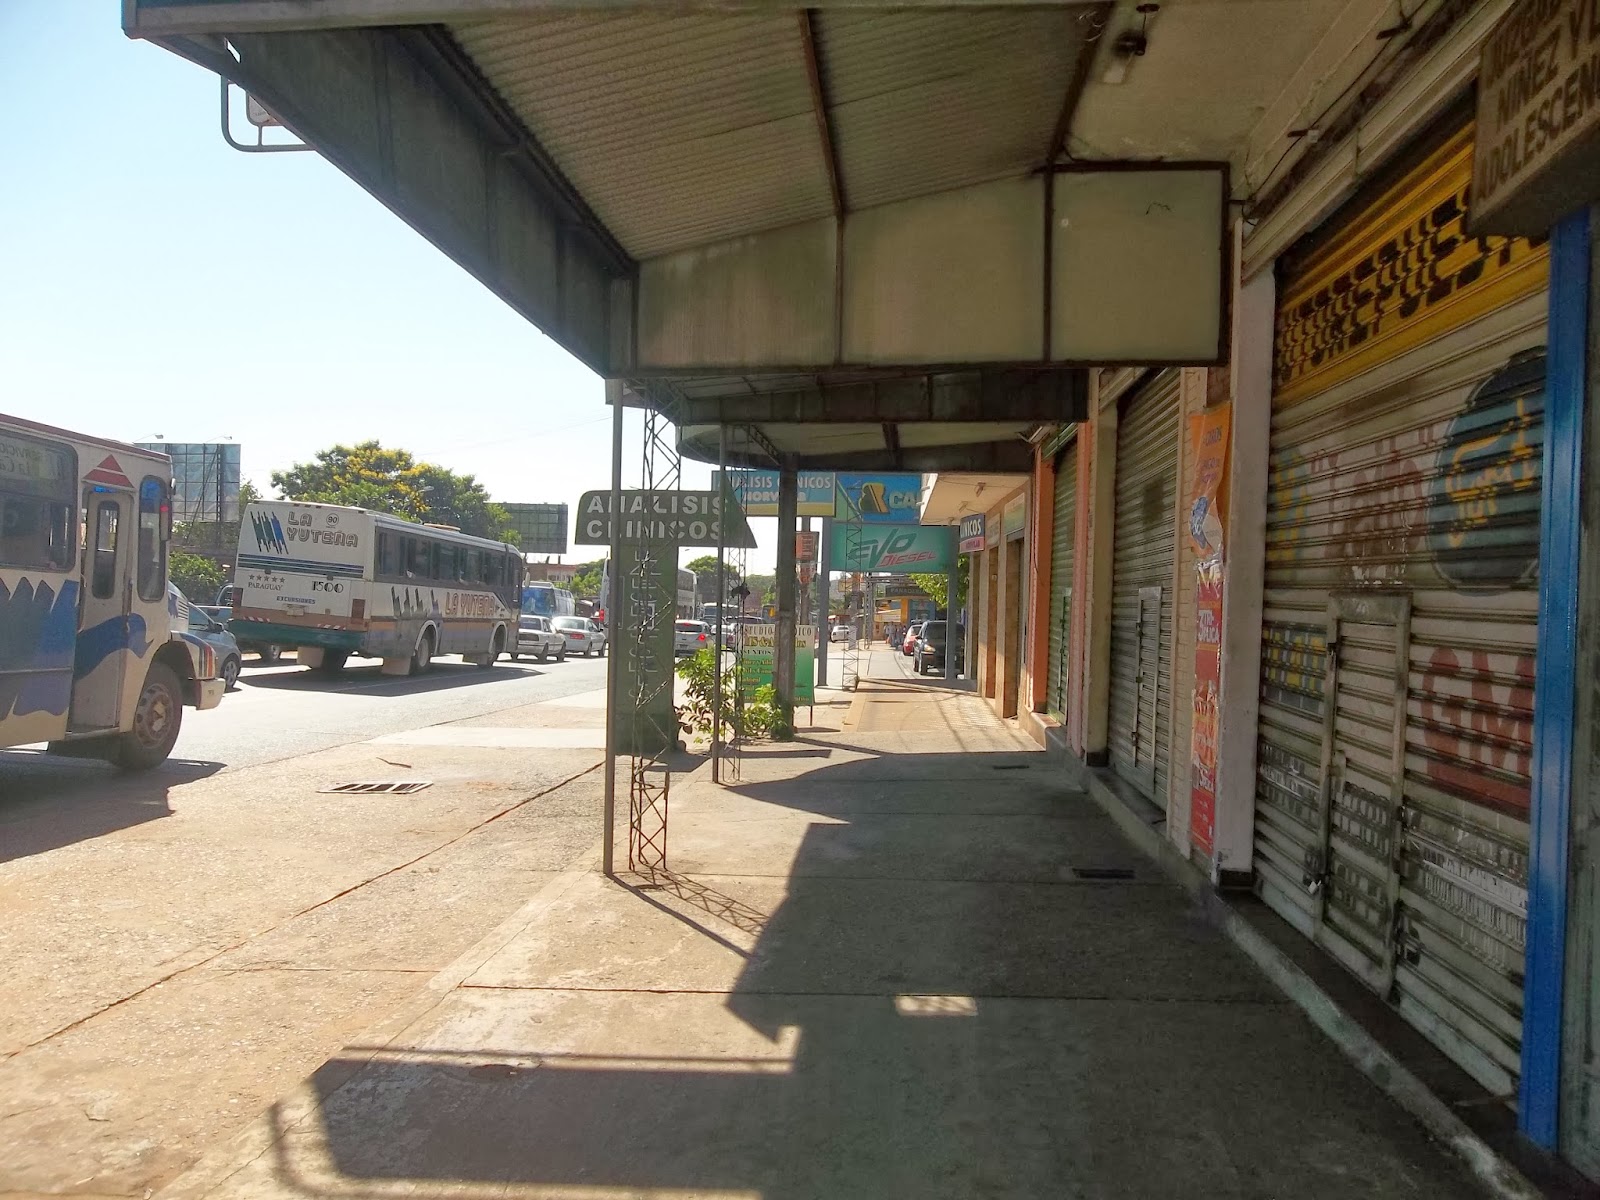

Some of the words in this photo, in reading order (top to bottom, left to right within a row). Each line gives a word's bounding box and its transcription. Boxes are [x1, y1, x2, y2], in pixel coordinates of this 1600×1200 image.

[1475, 53, 1600, 201] ADOLESCEN
[718, 476, 772, 489] NALISIS
[287, 511, 313, 526] LA
[328, 515, 338, 524] 90
[848, 529, 917, 568] EVO
[248, 581, 283, 592] PARAGUAY
[276, 596, 316, 605] EXCURSIONES
[444, 592, 459, 616] LA
